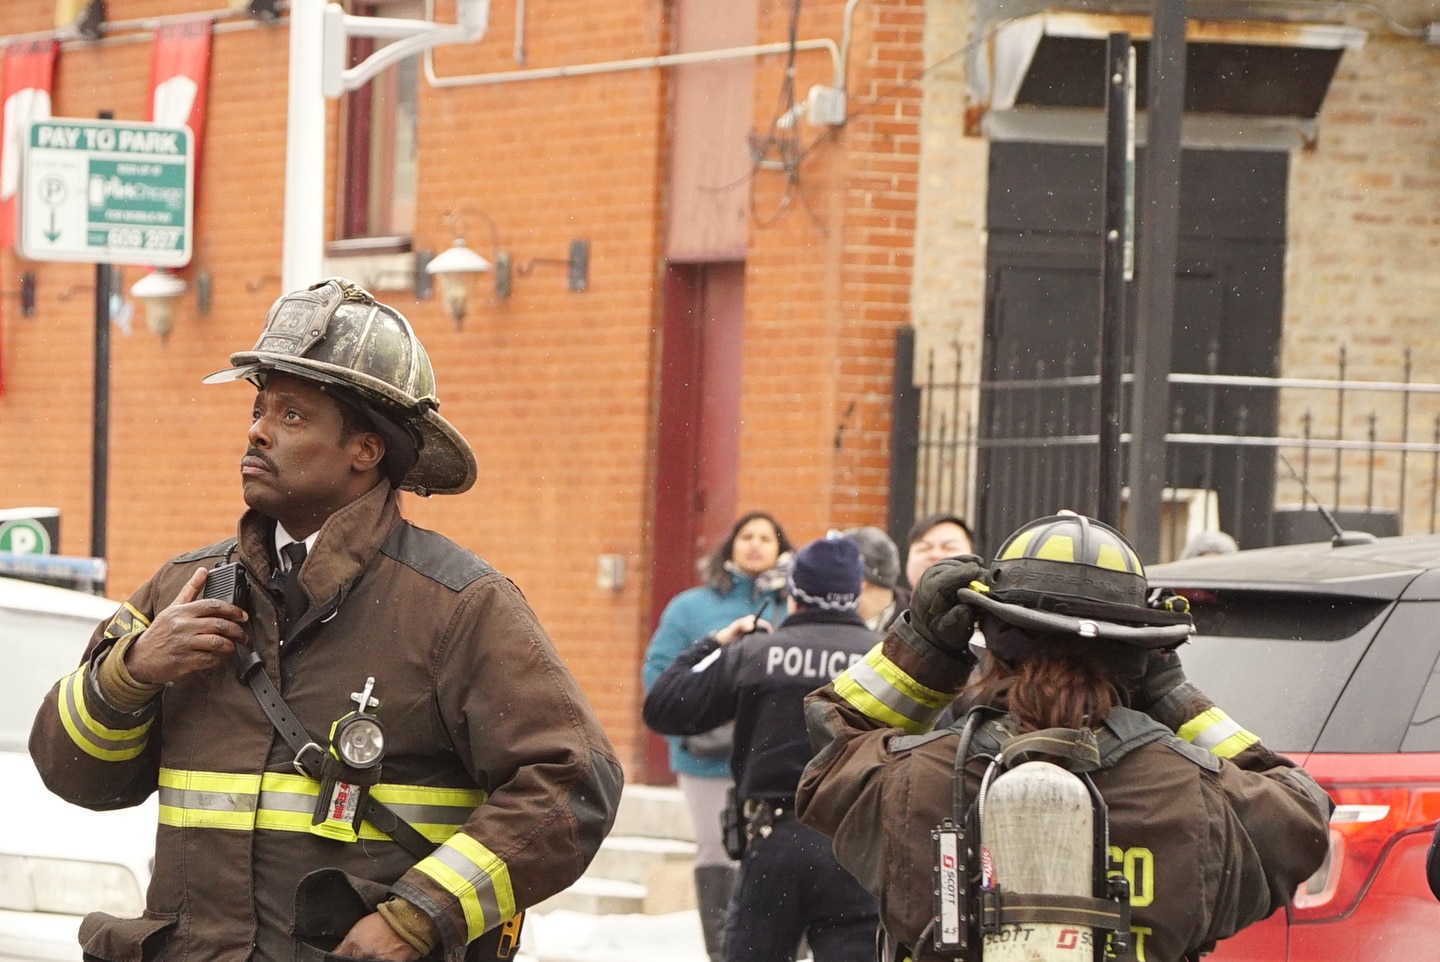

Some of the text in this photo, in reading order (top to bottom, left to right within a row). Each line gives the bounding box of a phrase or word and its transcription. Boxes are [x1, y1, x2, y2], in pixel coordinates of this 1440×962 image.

[38, 126, 178, 153] PAY TO PARK
[10, 526, 38, 554] P
[947, 870, 956, 906] SCOTT
[985, 928, 1035, 946] SCOTT
